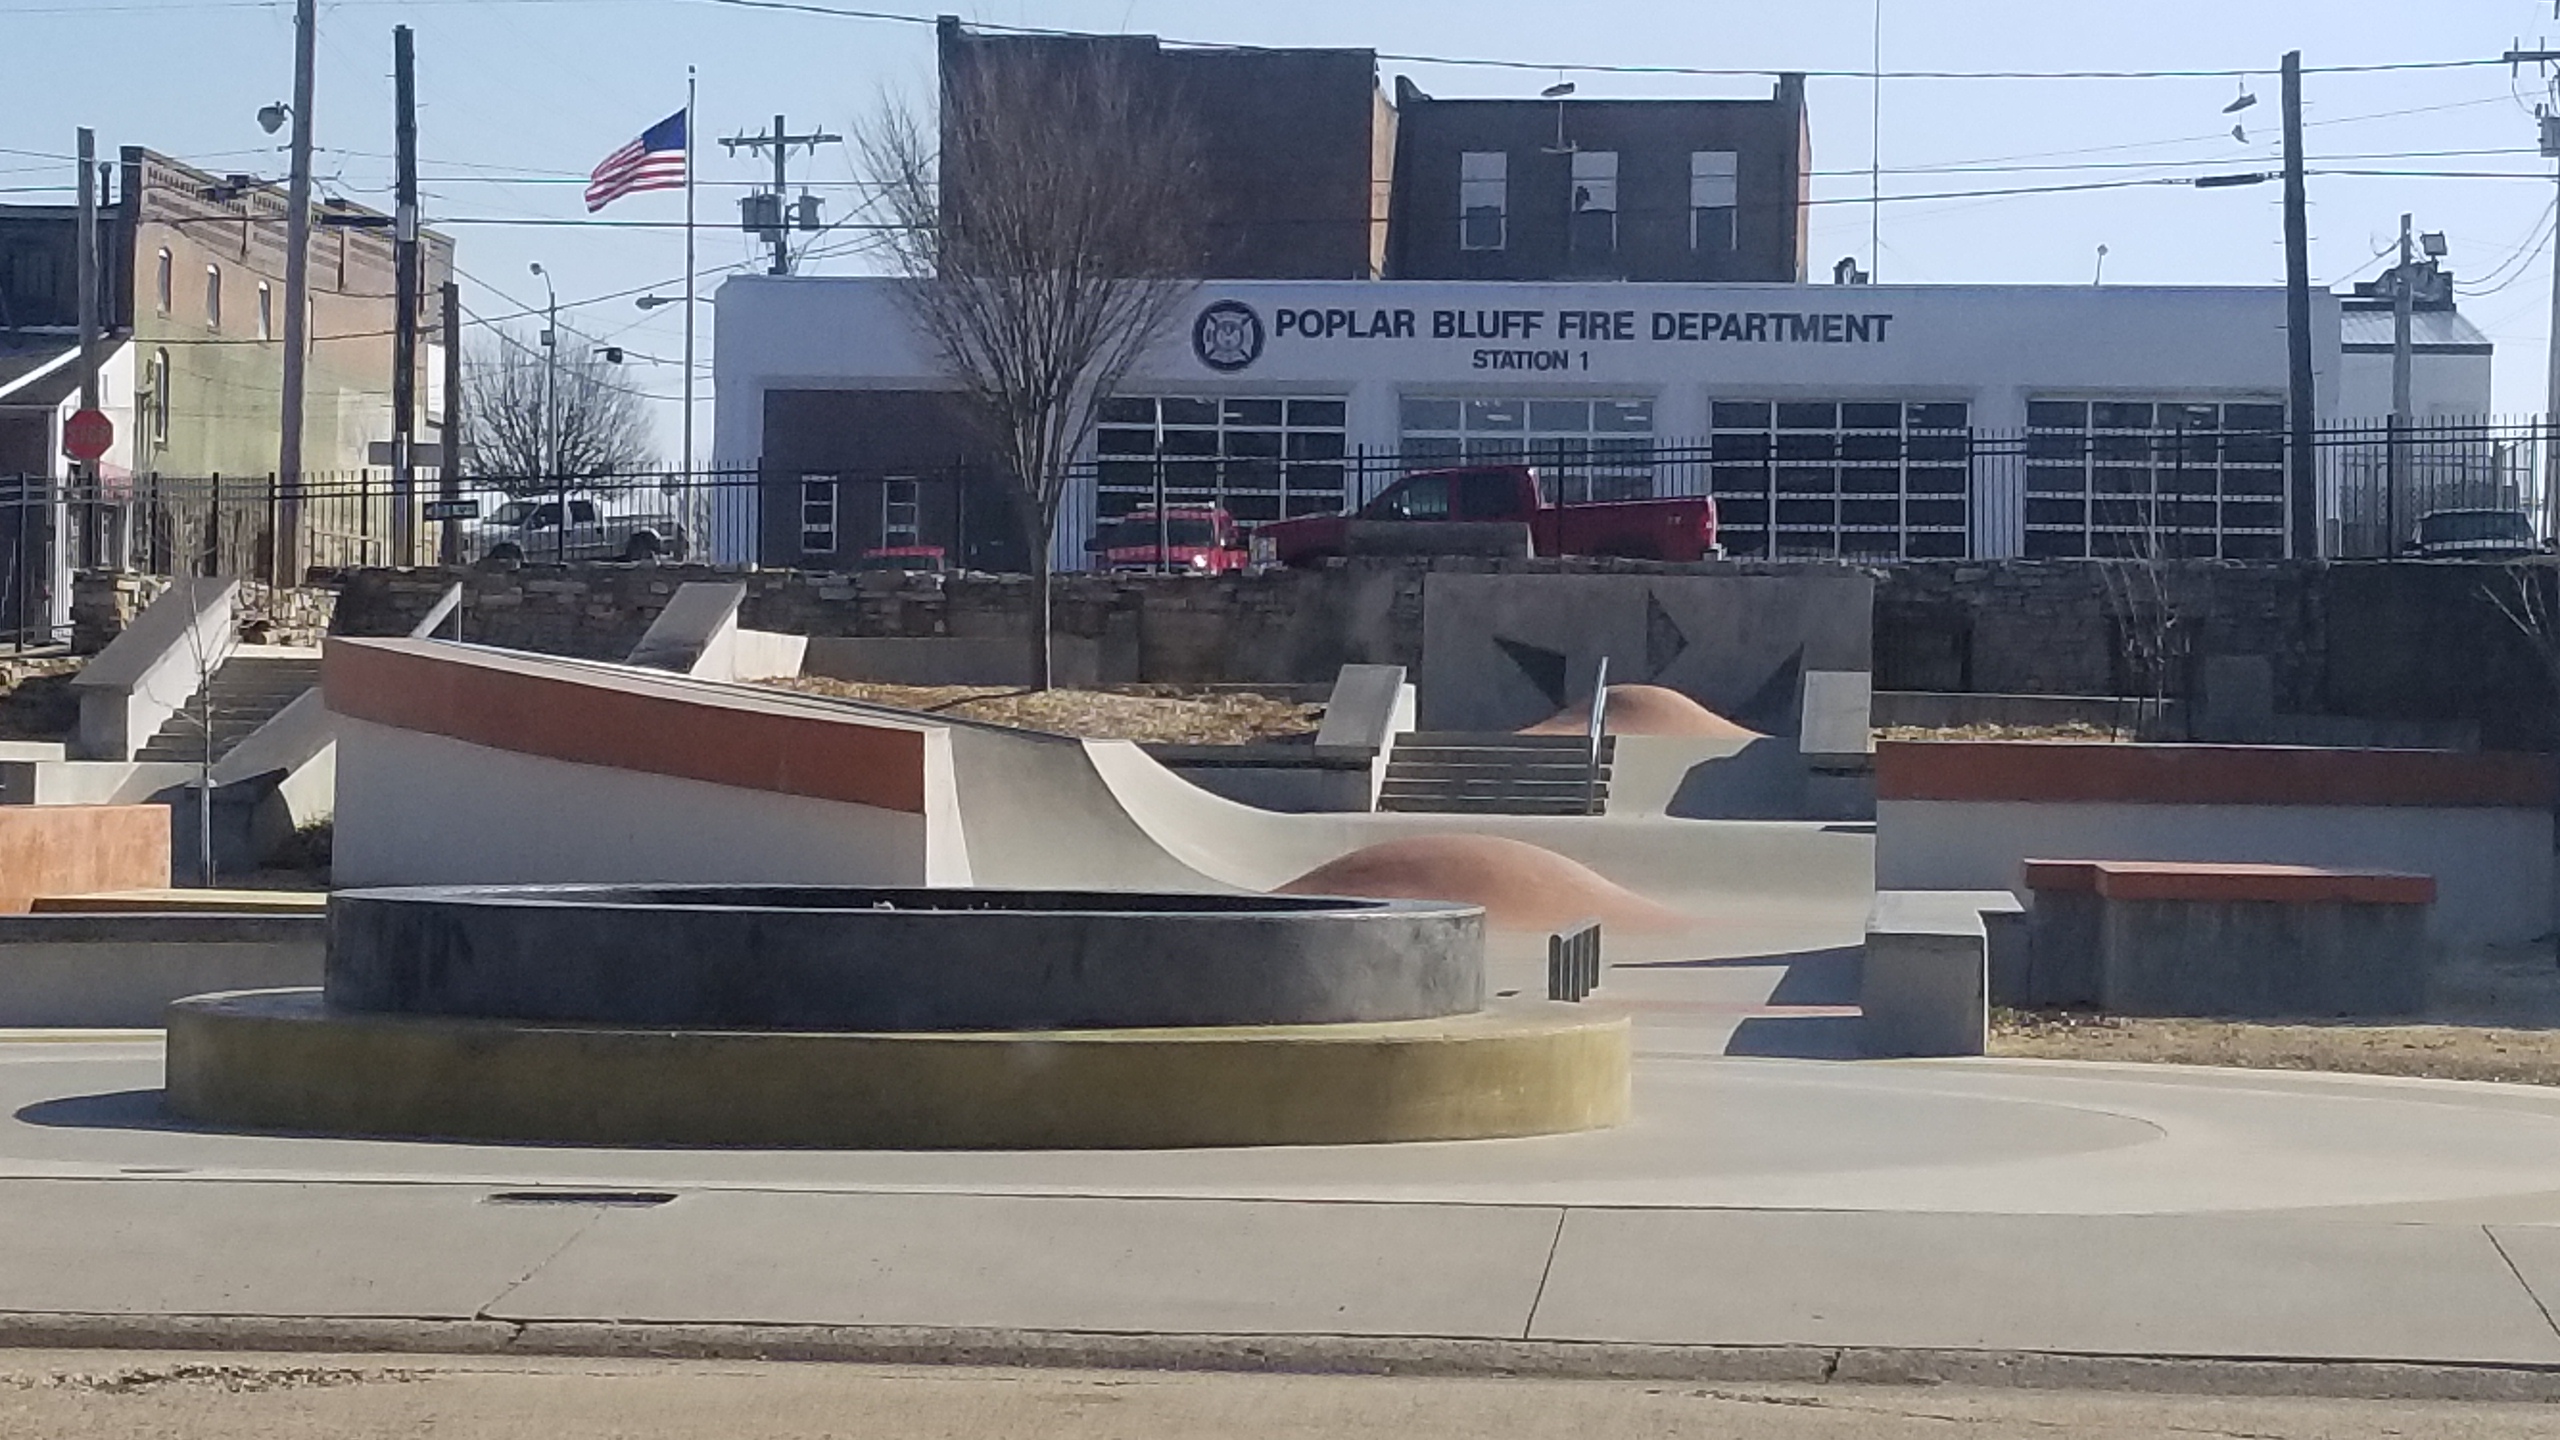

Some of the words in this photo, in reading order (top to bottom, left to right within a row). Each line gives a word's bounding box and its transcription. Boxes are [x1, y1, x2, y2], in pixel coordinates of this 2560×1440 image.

[1276, 309, 1415, 338] POPLAR
[1432, 310, 1544, 339] BLUFF
[1558, 310, 1635, 341] FIRE
[1651, 312, 1893, 343] DEPARTMENT
[1472, 349, 1569, 371] STATION
[1578, 350, 1589, 371] 1
